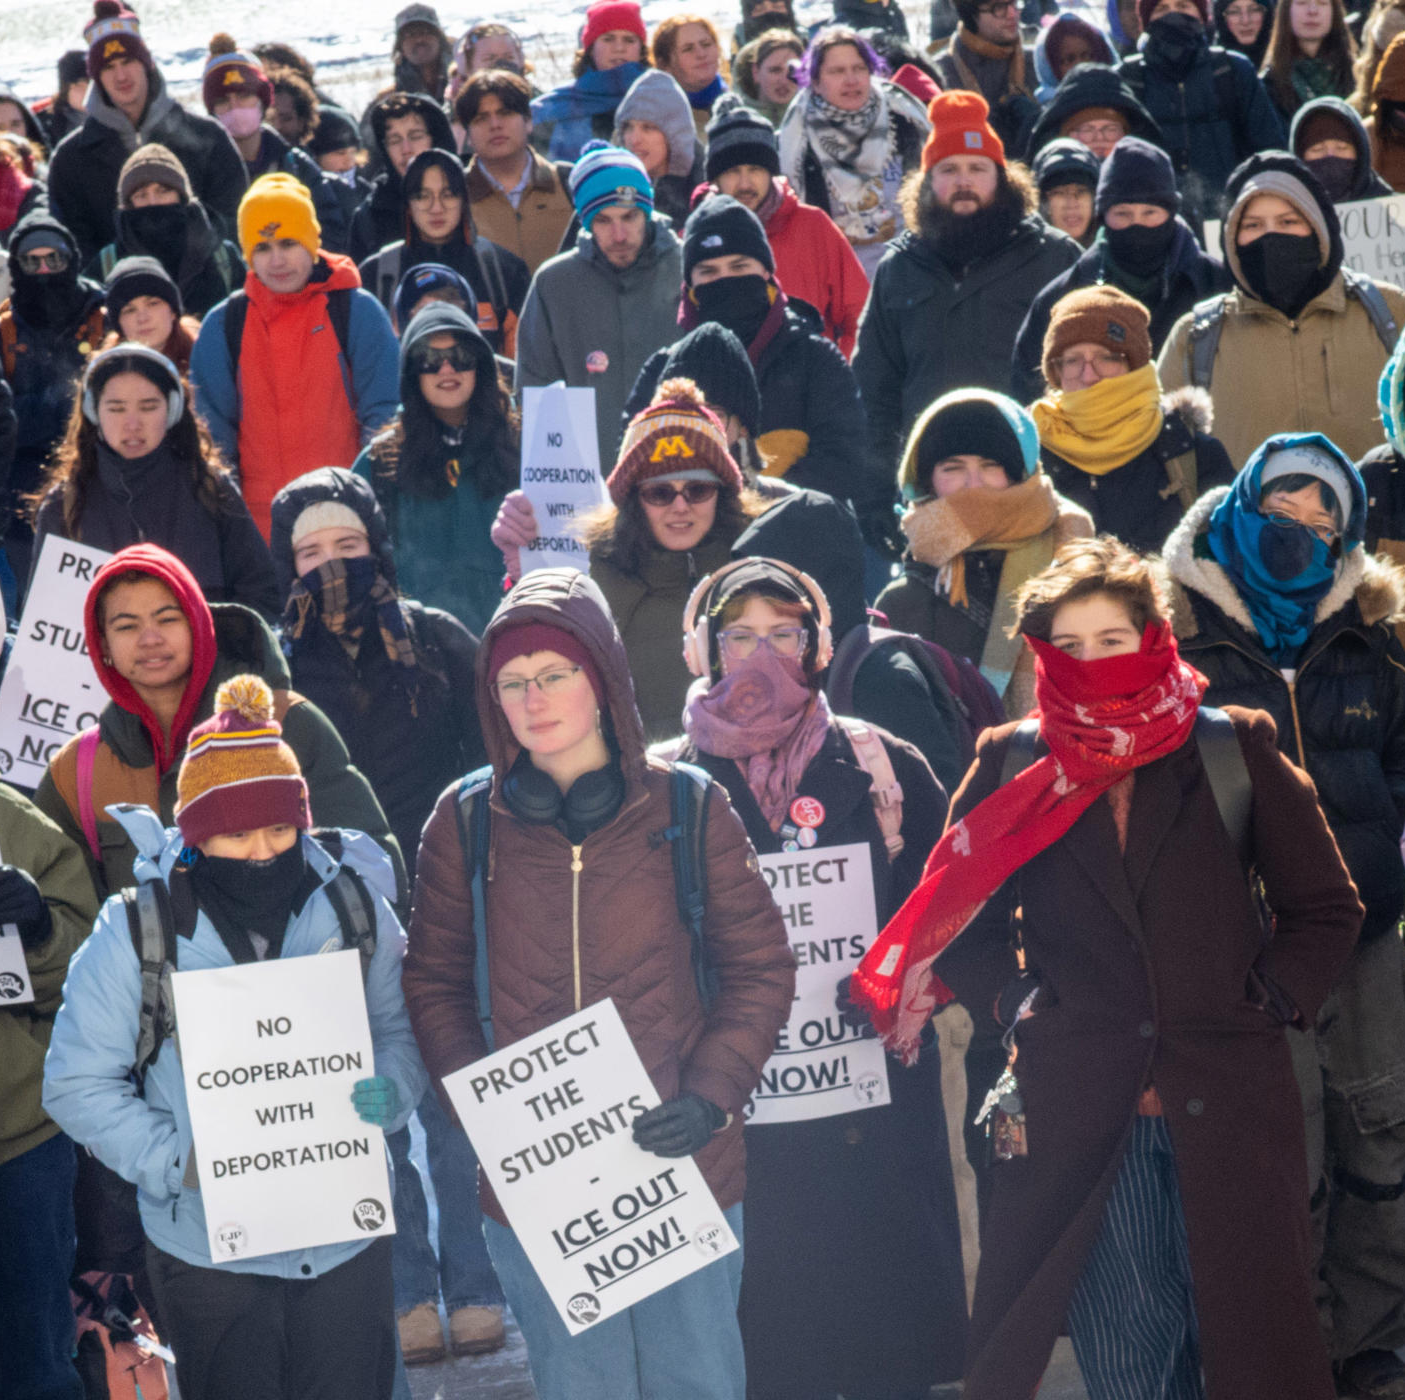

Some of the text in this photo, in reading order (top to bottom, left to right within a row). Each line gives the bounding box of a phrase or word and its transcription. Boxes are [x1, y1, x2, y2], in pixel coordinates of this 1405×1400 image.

[1336, 202, 1405, 241] OUR
[547, 432, 563, 448] NO
[547, 503, 575, 518] WITH
[21, 693, 70, 729] ICE
[762, 857, 849, 890] OTECT
[780, 902, 814, 928] HE
[795, 934, 866, 967] ENTS
[255, 1015, 293, 1039] NO
[197, 1051, 363, 1090] COOPERATION
[469, 1021, 601, 1104] PROTECT
[756, 1056, 850, 1095] NOW!
[255, 1101, 315, 1127] WITH
[524, 1078, 584, 1122] THE
[212, 1137, 370, 1179] DEPORTATION
[500, 1094, 650, 1184] STUDENTS
[551, 1167, 680, 1255] ICE OUT
[583, 1216, 687, 1288] NOW!
